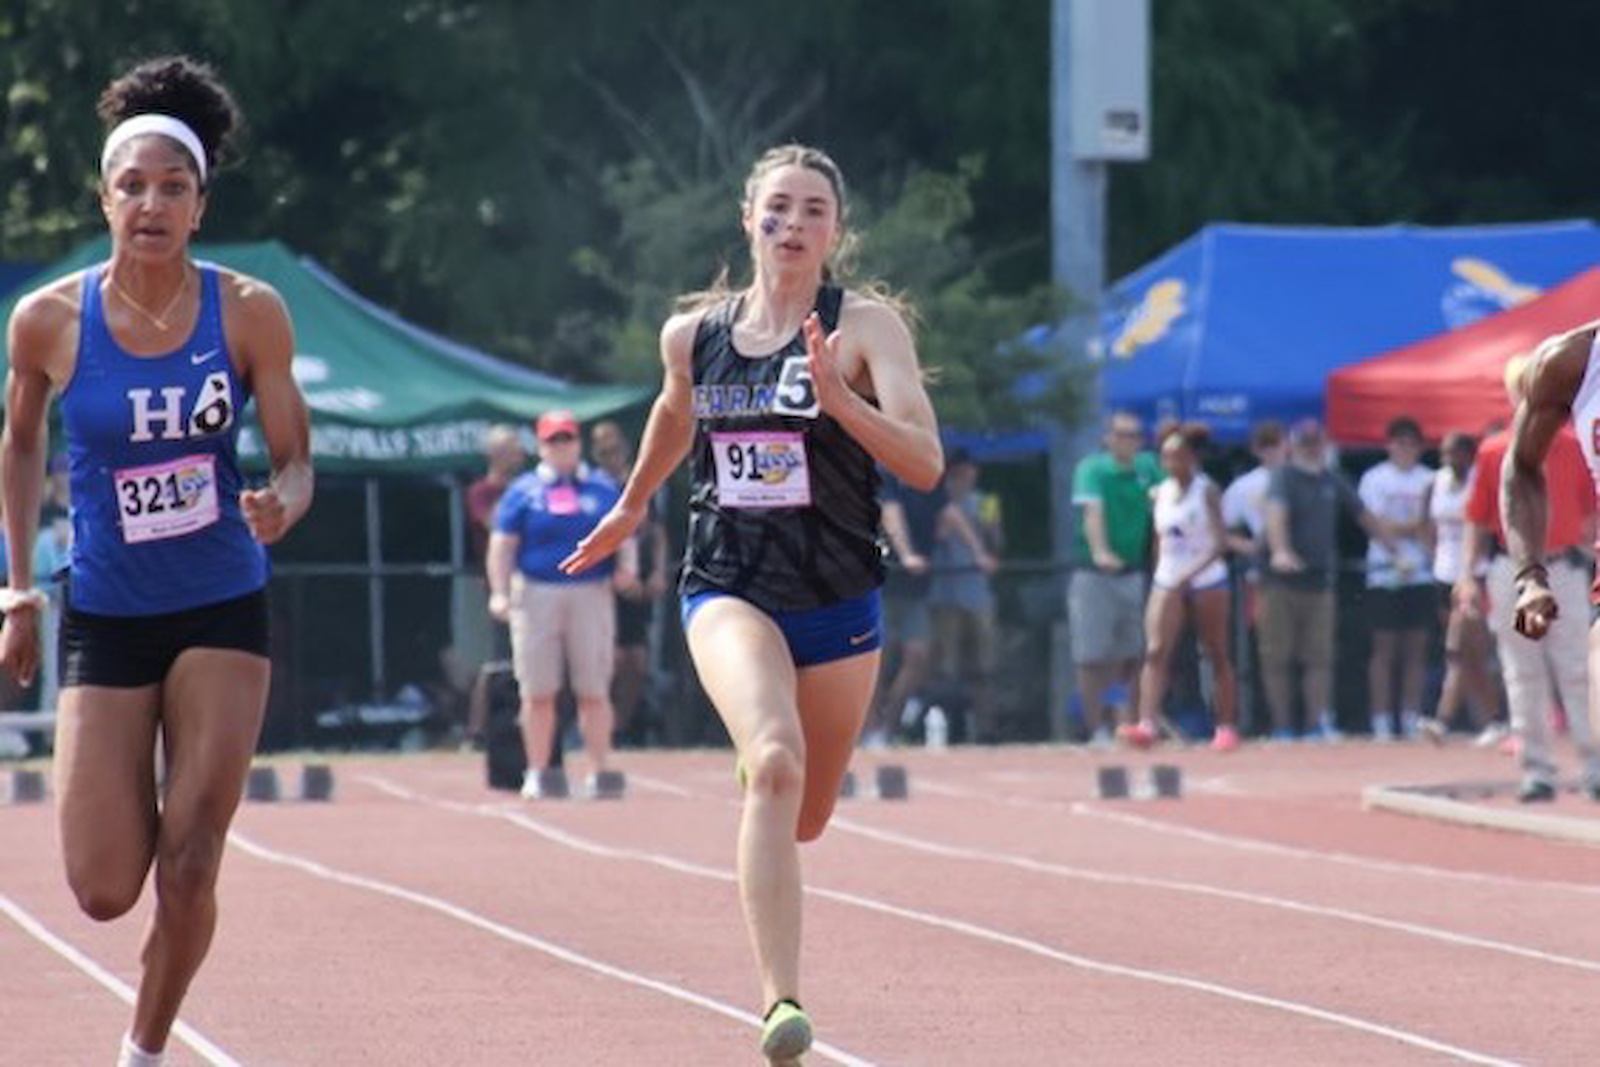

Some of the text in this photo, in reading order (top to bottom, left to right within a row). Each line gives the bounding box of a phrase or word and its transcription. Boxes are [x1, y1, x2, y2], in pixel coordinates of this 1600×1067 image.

[779, 361, 817, 410] 5
[127, 387, 186, 442] H
[727, 443, 764, 480] 91
[121, 473, 187, 517] 321
